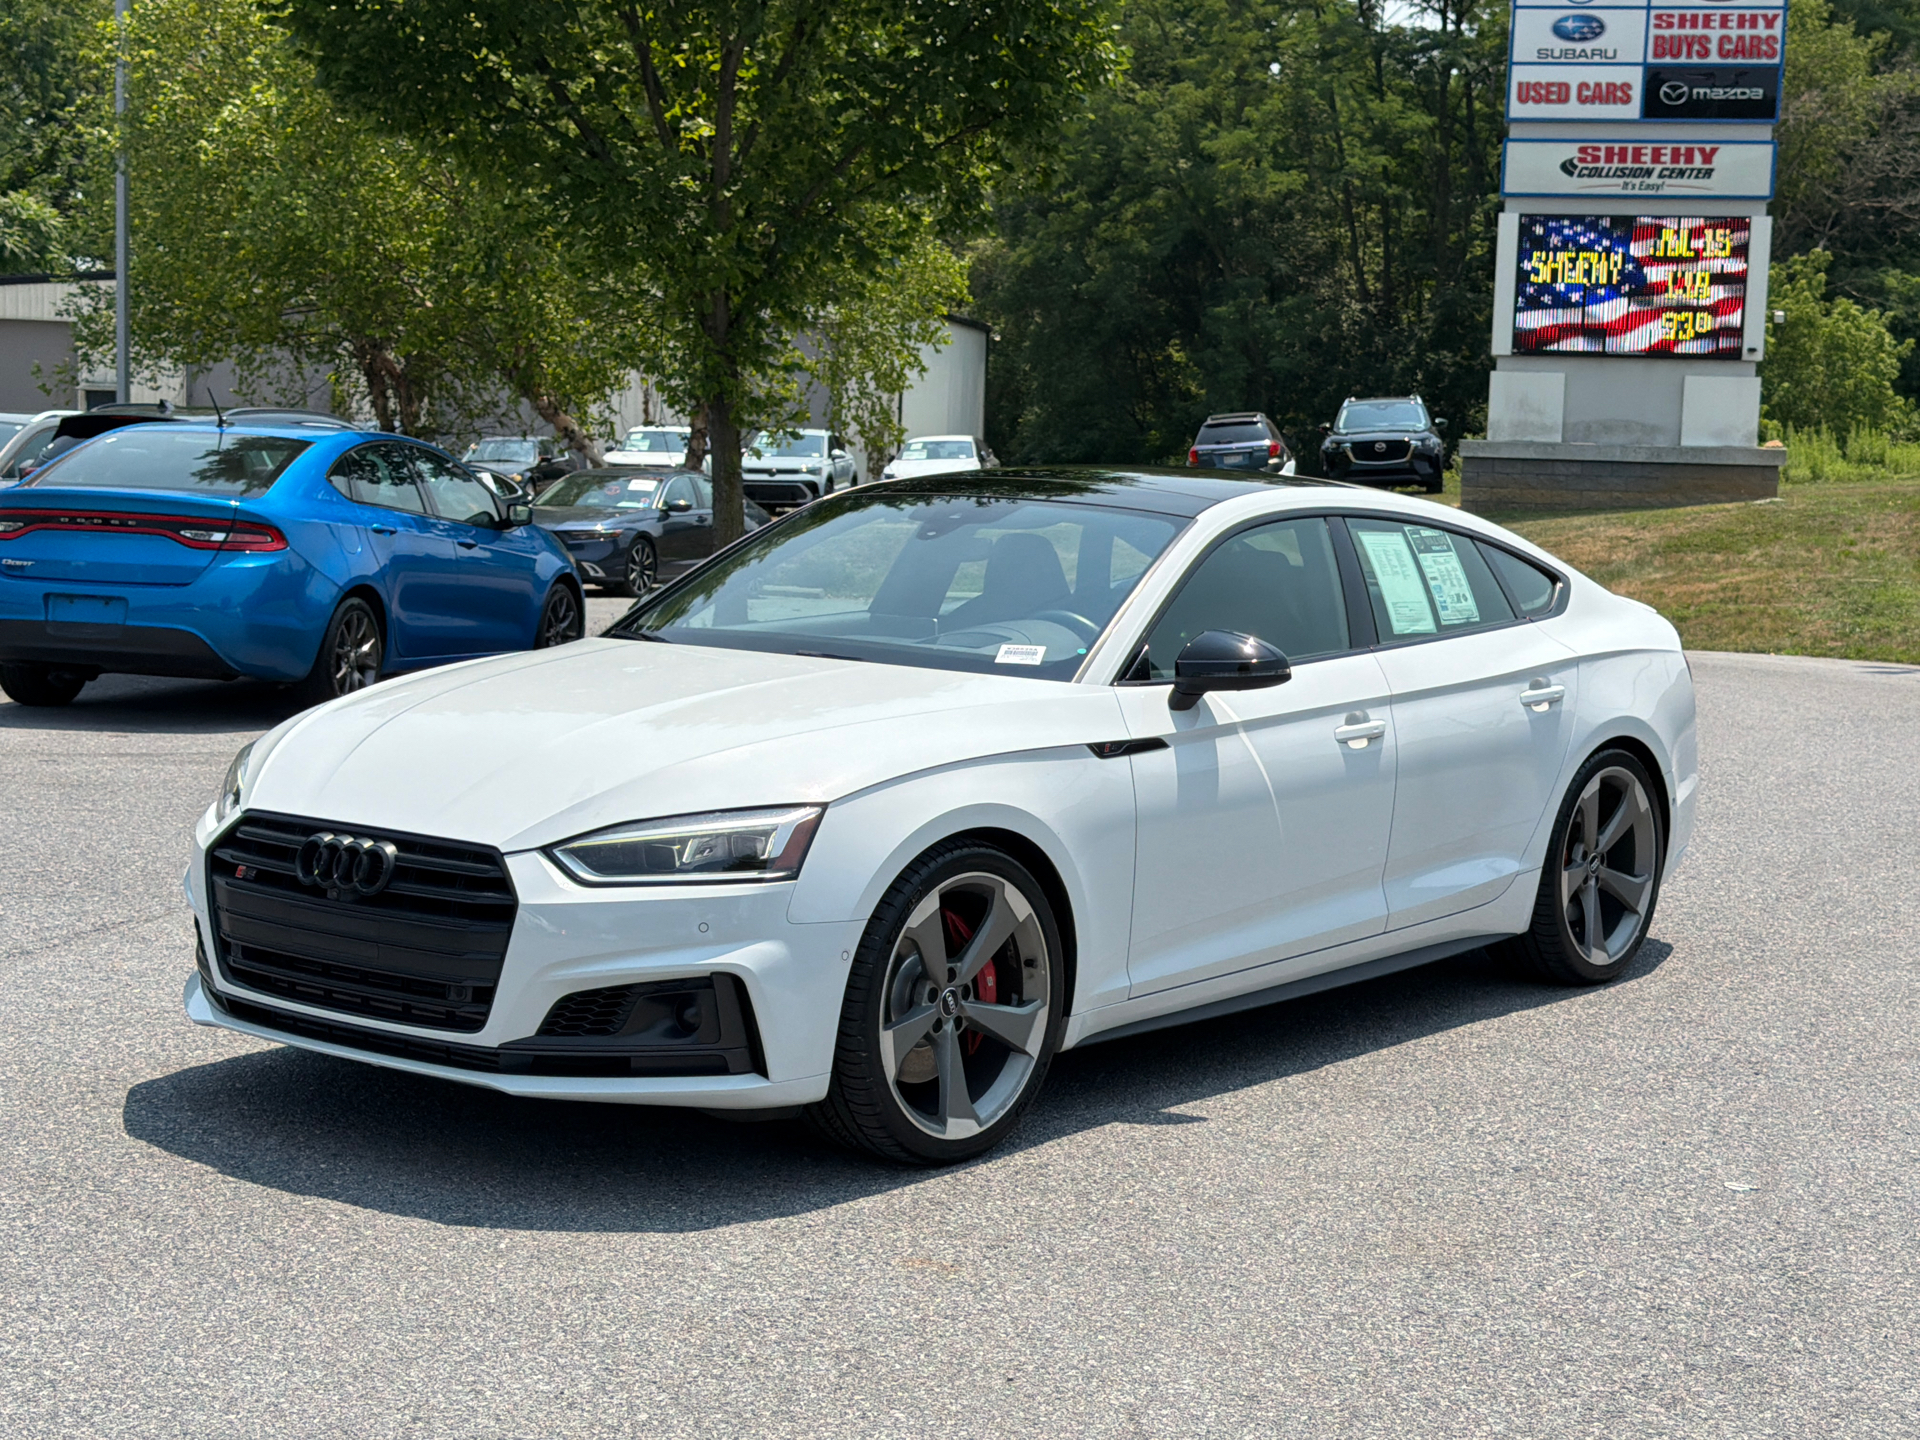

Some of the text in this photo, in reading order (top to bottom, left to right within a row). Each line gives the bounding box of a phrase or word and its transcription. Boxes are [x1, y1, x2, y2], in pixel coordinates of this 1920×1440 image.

[1653, 13, 1780, 30] SHEEHY
[1536, 48, 1617, 60] SUBARU
[1653, 35, 1779, 60] BUYS CARS
[1517, 81, 1632, 105] USED CARS
[1577, 145, 1720, 165] SHEEHY
[1576, 166, 1715, 180] COLLISION CENTER
[1621, 181, 1665, 193] It's Easy!
